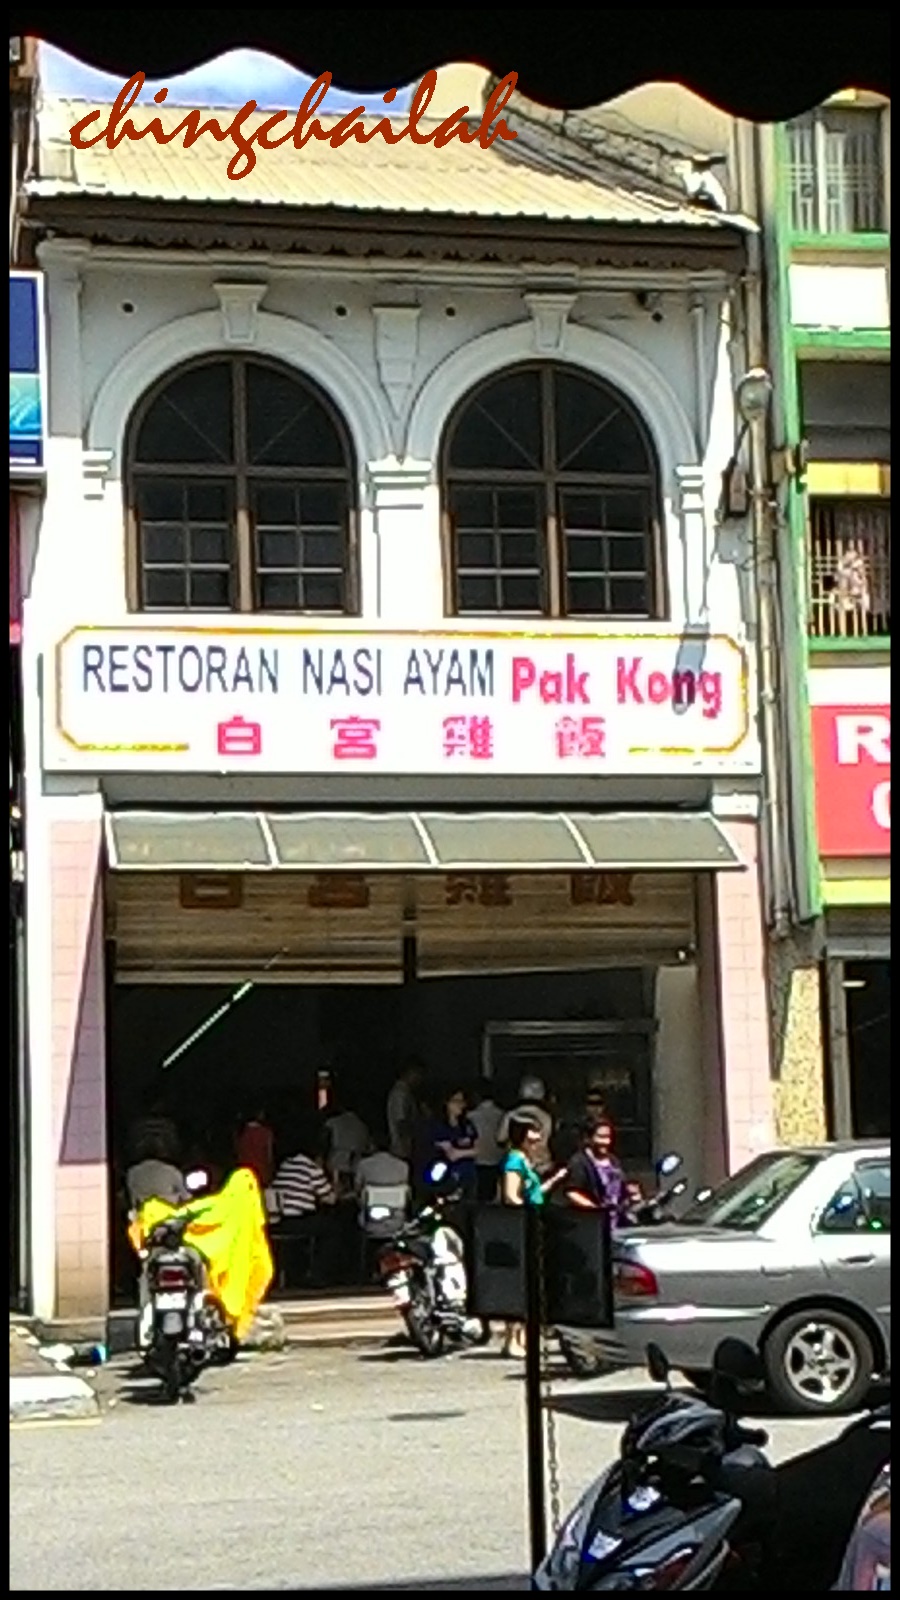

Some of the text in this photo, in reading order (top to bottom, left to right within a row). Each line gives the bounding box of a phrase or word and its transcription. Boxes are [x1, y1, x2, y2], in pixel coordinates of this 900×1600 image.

[83, 645, 722, 719] RESTORAN NASI AYAM Pak Kong
